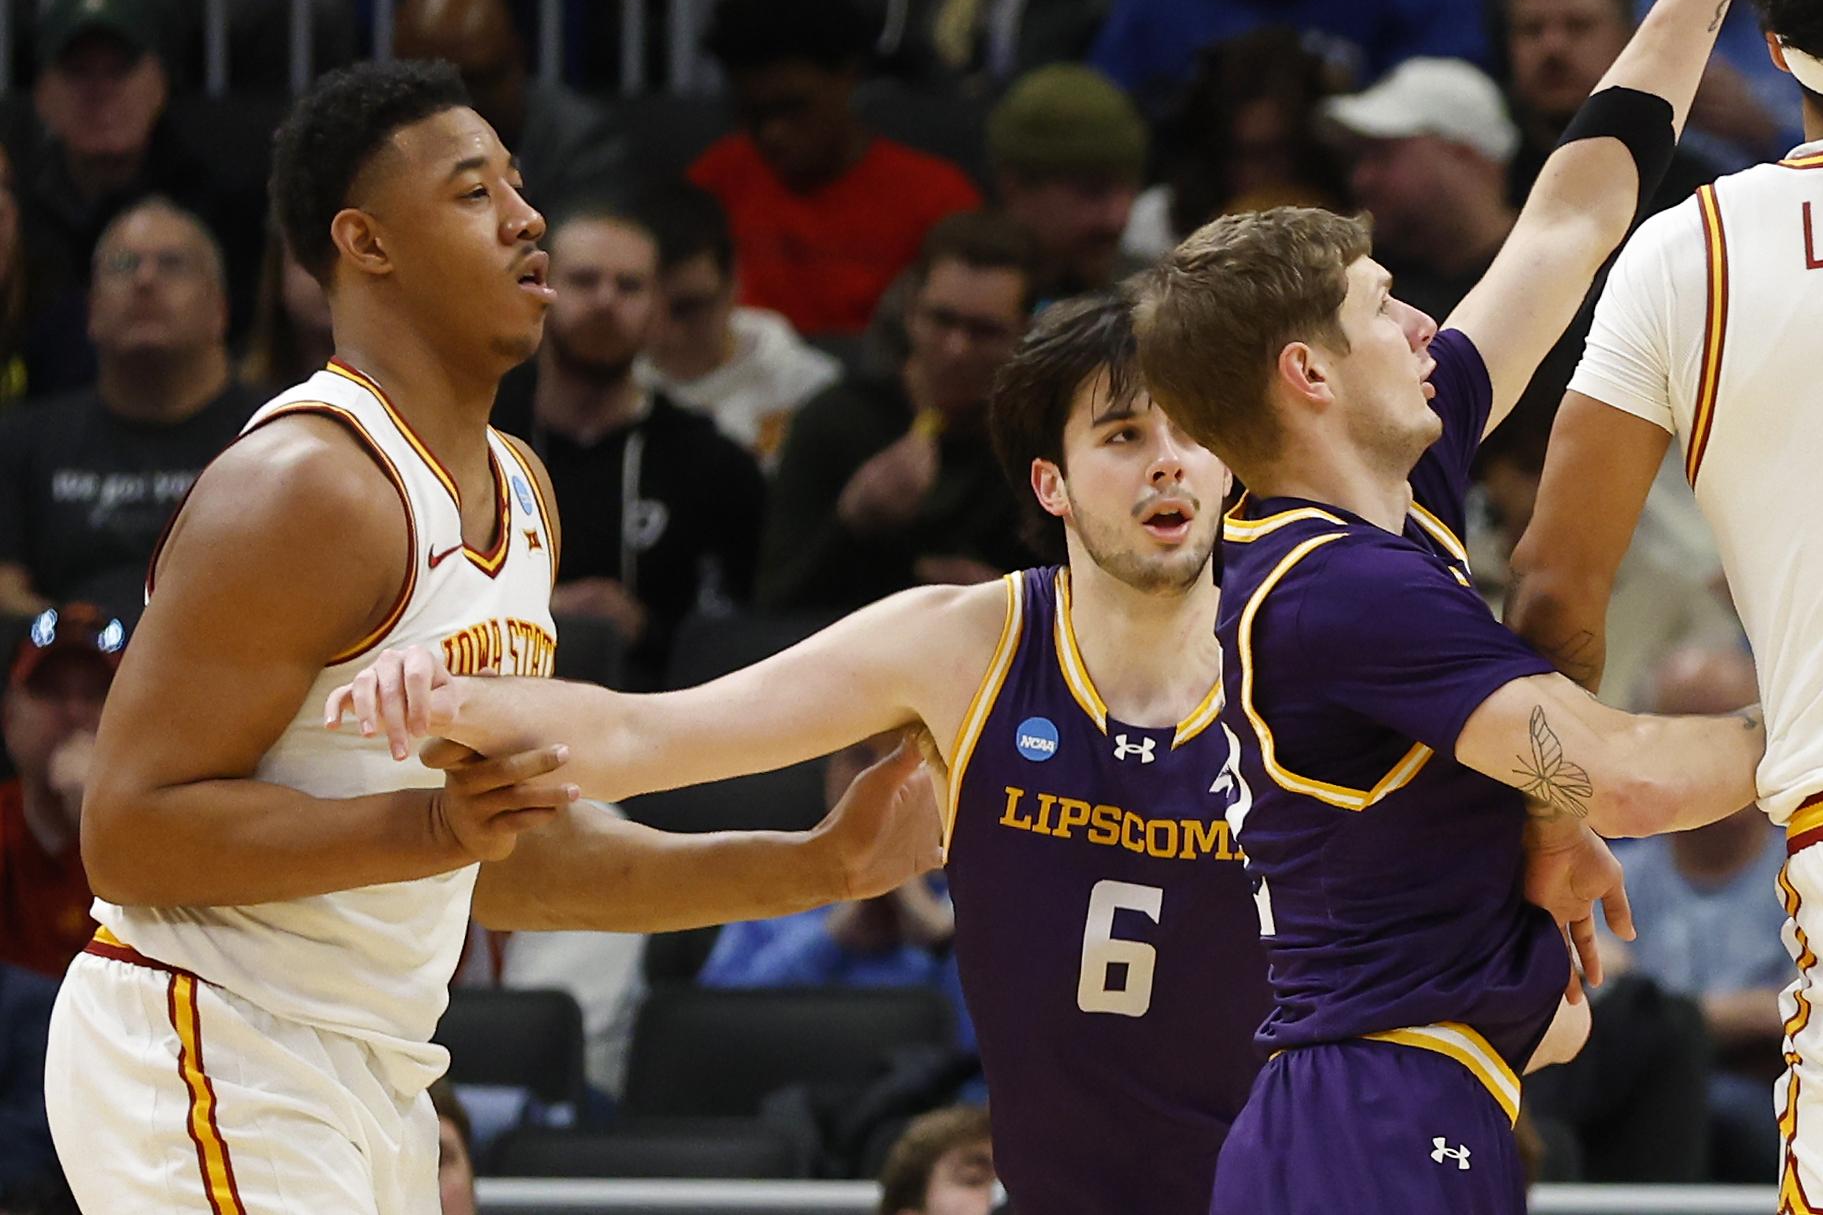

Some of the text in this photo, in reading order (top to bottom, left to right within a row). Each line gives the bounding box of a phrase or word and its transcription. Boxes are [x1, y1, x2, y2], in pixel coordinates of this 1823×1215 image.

[440, 615, 557, 676] IOWA STAT
[1020, 734, 1057, 754] NCAA
[999, 785, 1248, 862] LIPSCOM
[1076, 879, 1164, 1018] 6
